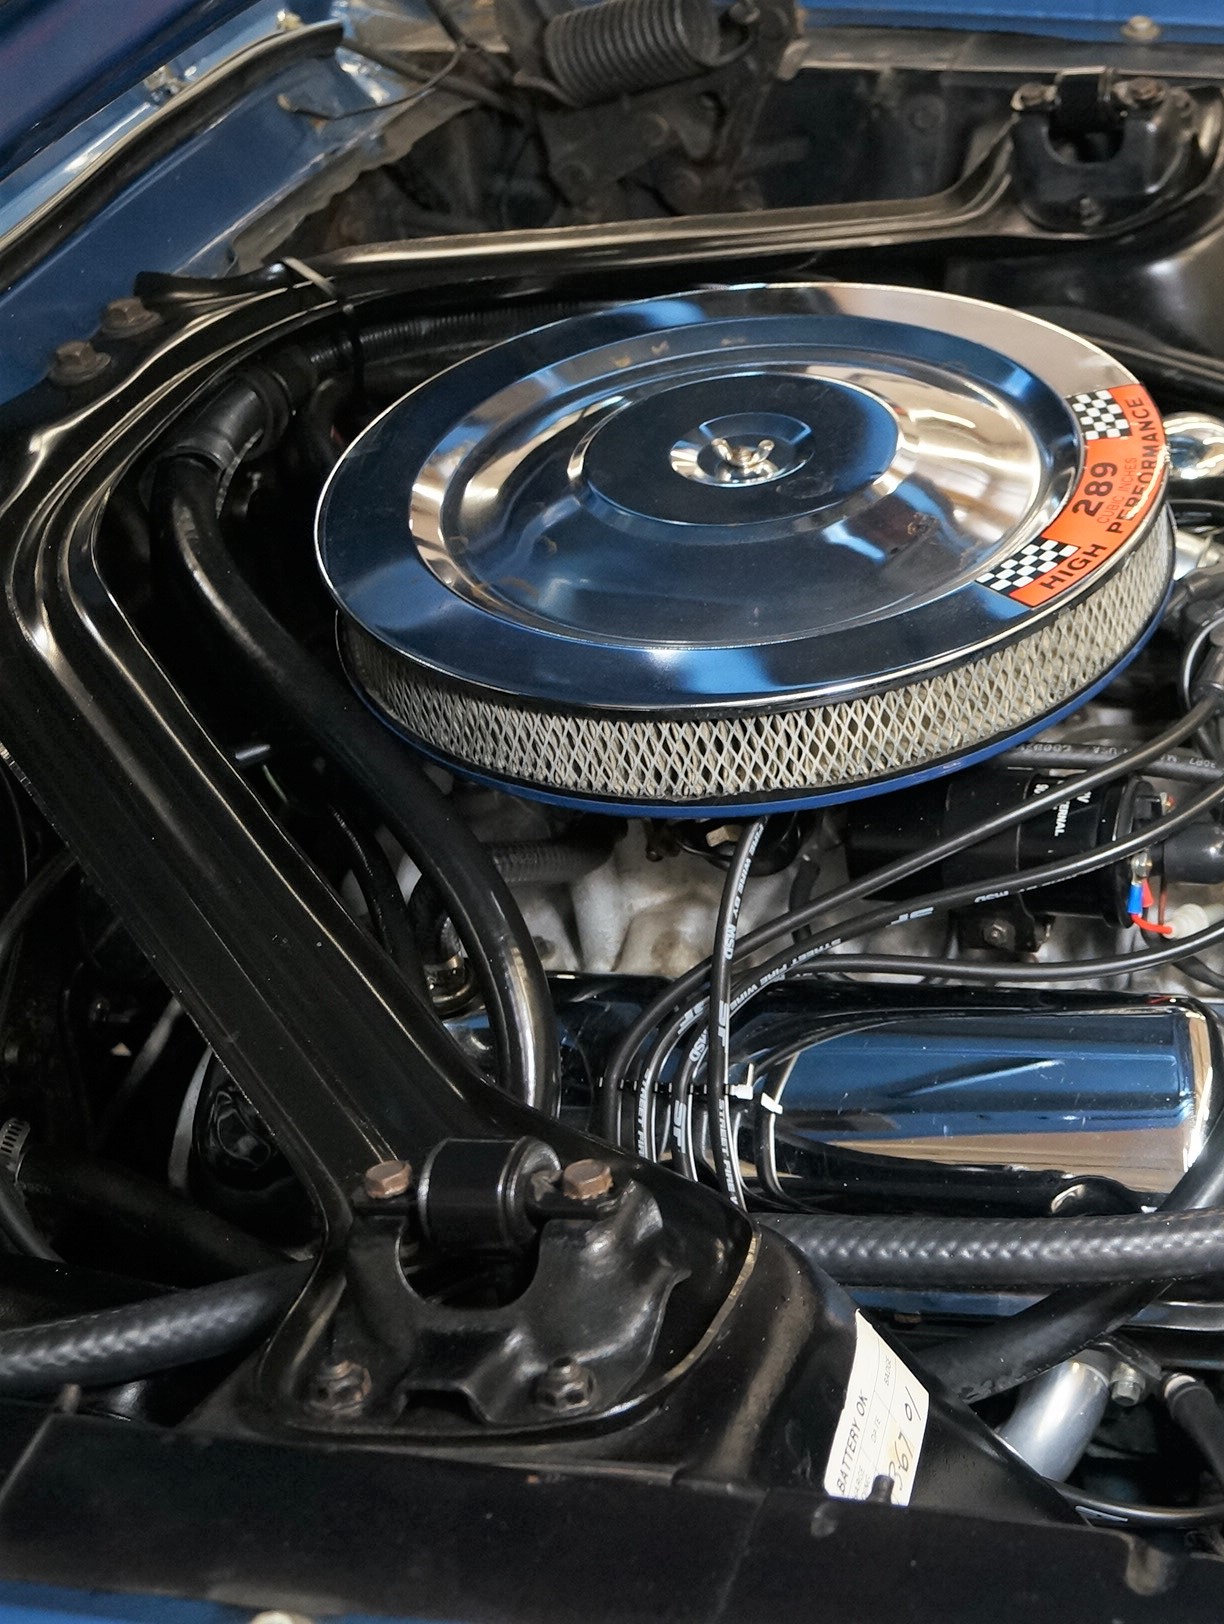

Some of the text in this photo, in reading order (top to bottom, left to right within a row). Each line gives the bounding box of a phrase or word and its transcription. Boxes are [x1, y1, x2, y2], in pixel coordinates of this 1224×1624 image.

[1040, 397, 1158, 590] HIGH PERFORMANCE
[1072, 462, 1118, 516] 289
[1097, 458, 1138, 524] CUBIC INCHES
[738, 858, 752, 894] WIRE
[732, 896, 741, 920] BY
[724, 923, 736, 960] MSD
[760, 963, 788, 986] FIRE
[730, 984, 758, 1011] WIRE
[718, 1098, 730, 1159] STREET
[722, 1159, 736, 1195] FIRE
[836, 1389, 868, 1495] BATTERY OK
